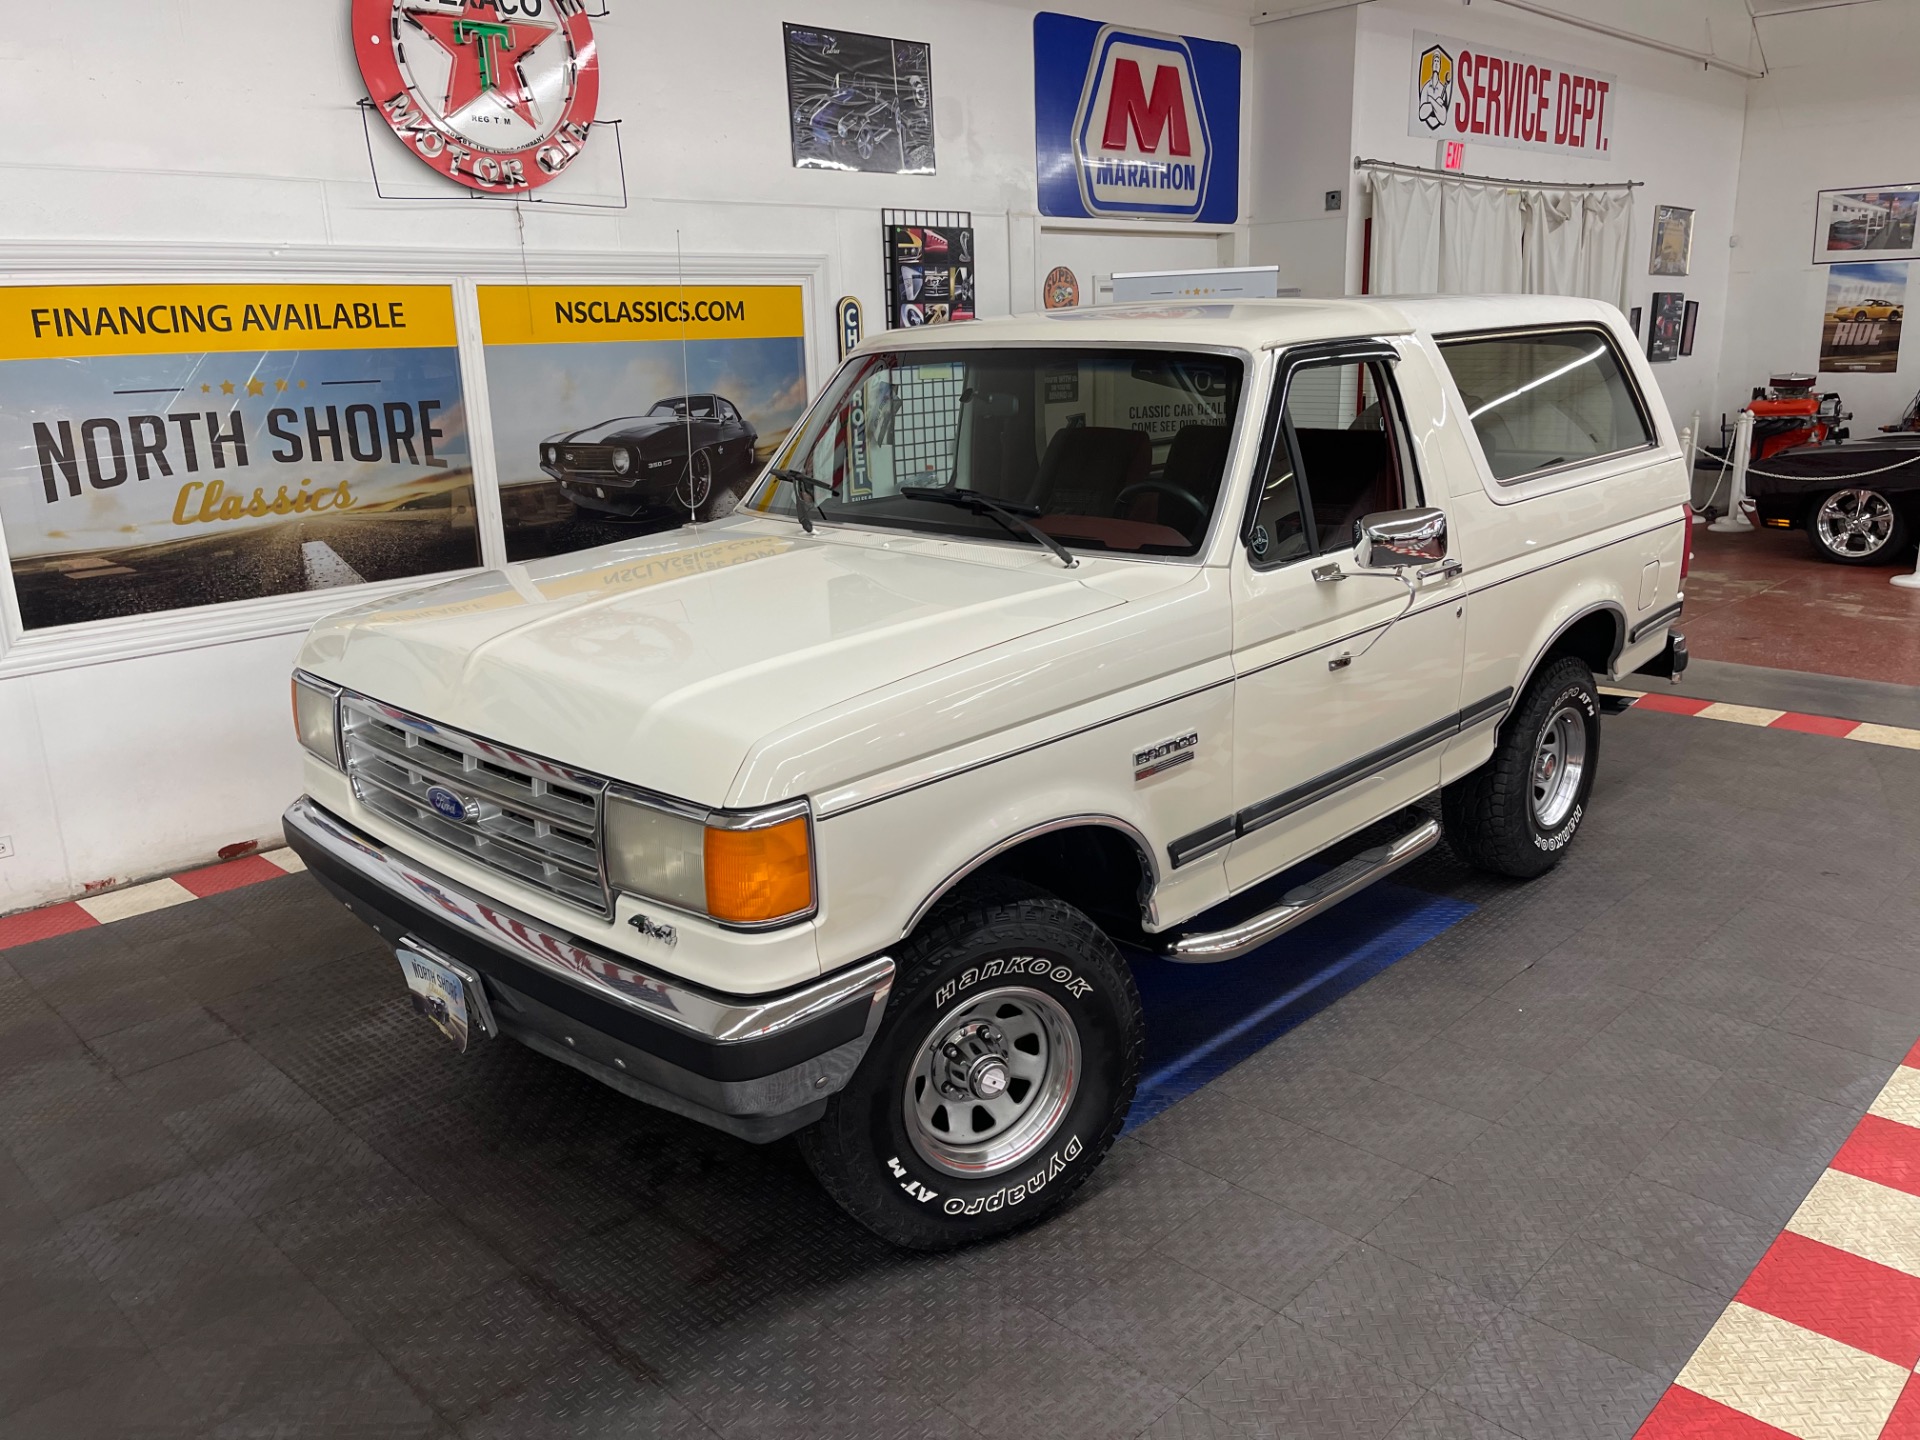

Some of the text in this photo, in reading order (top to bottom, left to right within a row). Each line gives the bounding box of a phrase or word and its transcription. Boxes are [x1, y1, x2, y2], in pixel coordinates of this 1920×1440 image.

[1101, 58, 1192, 156] M
[1455, 50, 1609, 151] SERVICE DEPT.
[384, 92, 592, 189] MOTOR OIL
[1445, 141, 1465, 171] EXIT
[1096, 156, 1196, 192] MARATHON
[31, 302, 407, 338] FINANCING AVAILABLE
[555, 299, 746, 325] NSCLASSICS.COM
[1832, 322, 1883, 346] RIDE
[1129, 404, 1171, 419] CLASSIC
[1174, 403, 1194, 417] CAR
[1131, 421, 1158, 434] COME
[1160, 420, 1176, 432] SEE
[32, 400, 448, 504] NORTH SHORE
[172, 479, 358, 526] Classics
[435, 792, 456, 815] Ford
[411, 960, 437, 984] NORTH
